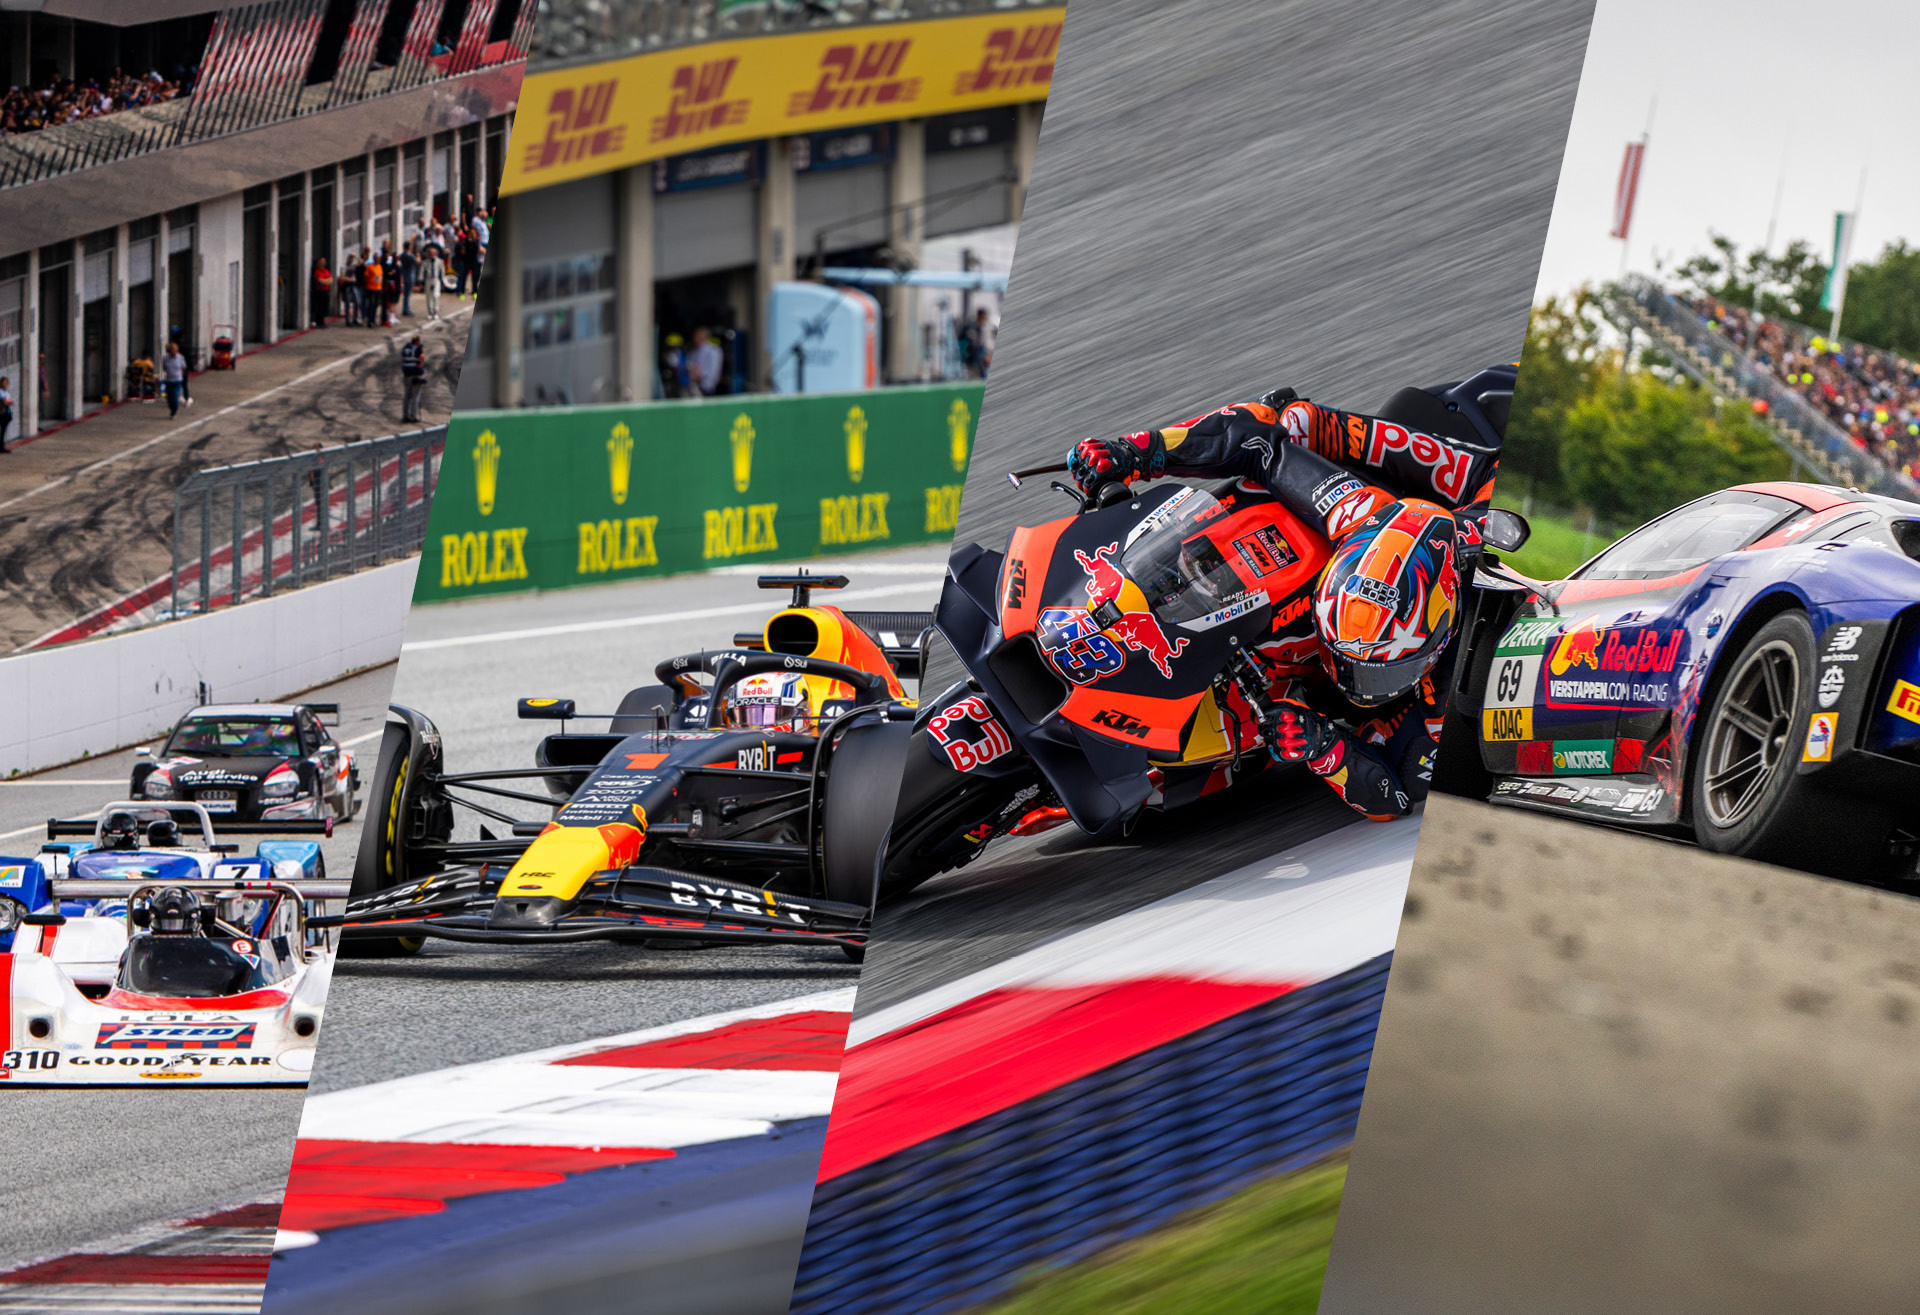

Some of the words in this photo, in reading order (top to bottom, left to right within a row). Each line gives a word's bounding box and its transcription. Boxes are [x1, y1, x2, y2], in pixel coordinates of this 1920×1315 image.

[1347, 414, 1367, 459] KTM
[1366, 419, 1474, 504] Red
[1328, 481, 1361, 503] Mobil
[820, 492, 890, 545] ROLEX
[1153, 497, 1180, 517] Mobil
[1192, 493, 1237, 523] KTM
[704, 503, 778, 559] ROLEX
[440, 528, 528, 587] ROLEX
[578, 516, 659, 574] ROLEX
[1246, 541, 1270, 567] KTM
[1256, 529, 1275, 550] Red
[1269, 547, 1289, 568] Bull
[1233, 541, 1250, 562] FACTORY
[1248, 560, 1264, 577] RACING
[1008, 559, 1027, 609] KTM
[1222, 590, 1245, 603] READY
[1244, 588, 1262, 599] RACE
[1215, 604, 1244, 623] Mobil
[1244, 600, 1254, 610] 1
[1359, 586, 1401, 610] LOCK
[1272, 595, 1311, 633] KTM
[1037, 607, 1125, 686] 43
[1498, 621, 1560, 648] DEKRA
[711, 652, 747, 667] BILLA
[1601, 629, 1646, 671] Red
[1638, 629, 1685, 672] Bull
[742, 687, 756, 695] Red
[757, 687, 773, 695] Bull
[1497, 660, 1523, 702] 69
[1550, 680, 1629, 700] VERSTAPPEN.COM
[1633, 683, 1669, 702] RACING
[734, 697, 780, 706] ORACLE
[927, 696, 993, 745] Red
[1092, 709, 1151, 739] KTM
[1492, 709, 1522, 739] ADAC
[944, 719, 1012, 773] Bull
[184, 769, 226, 777] Audi
[624, 753, 671, 770] 1
[1564, 751, 1611, 769] MOTOREX
[178, 774, 203, 783] Top
[206, 773, 258, 782] Service
[231, 866, 249, 879] 7
[125, 1028, 235, 1036] STEED
[4, 1051, 60, 1069] 310
